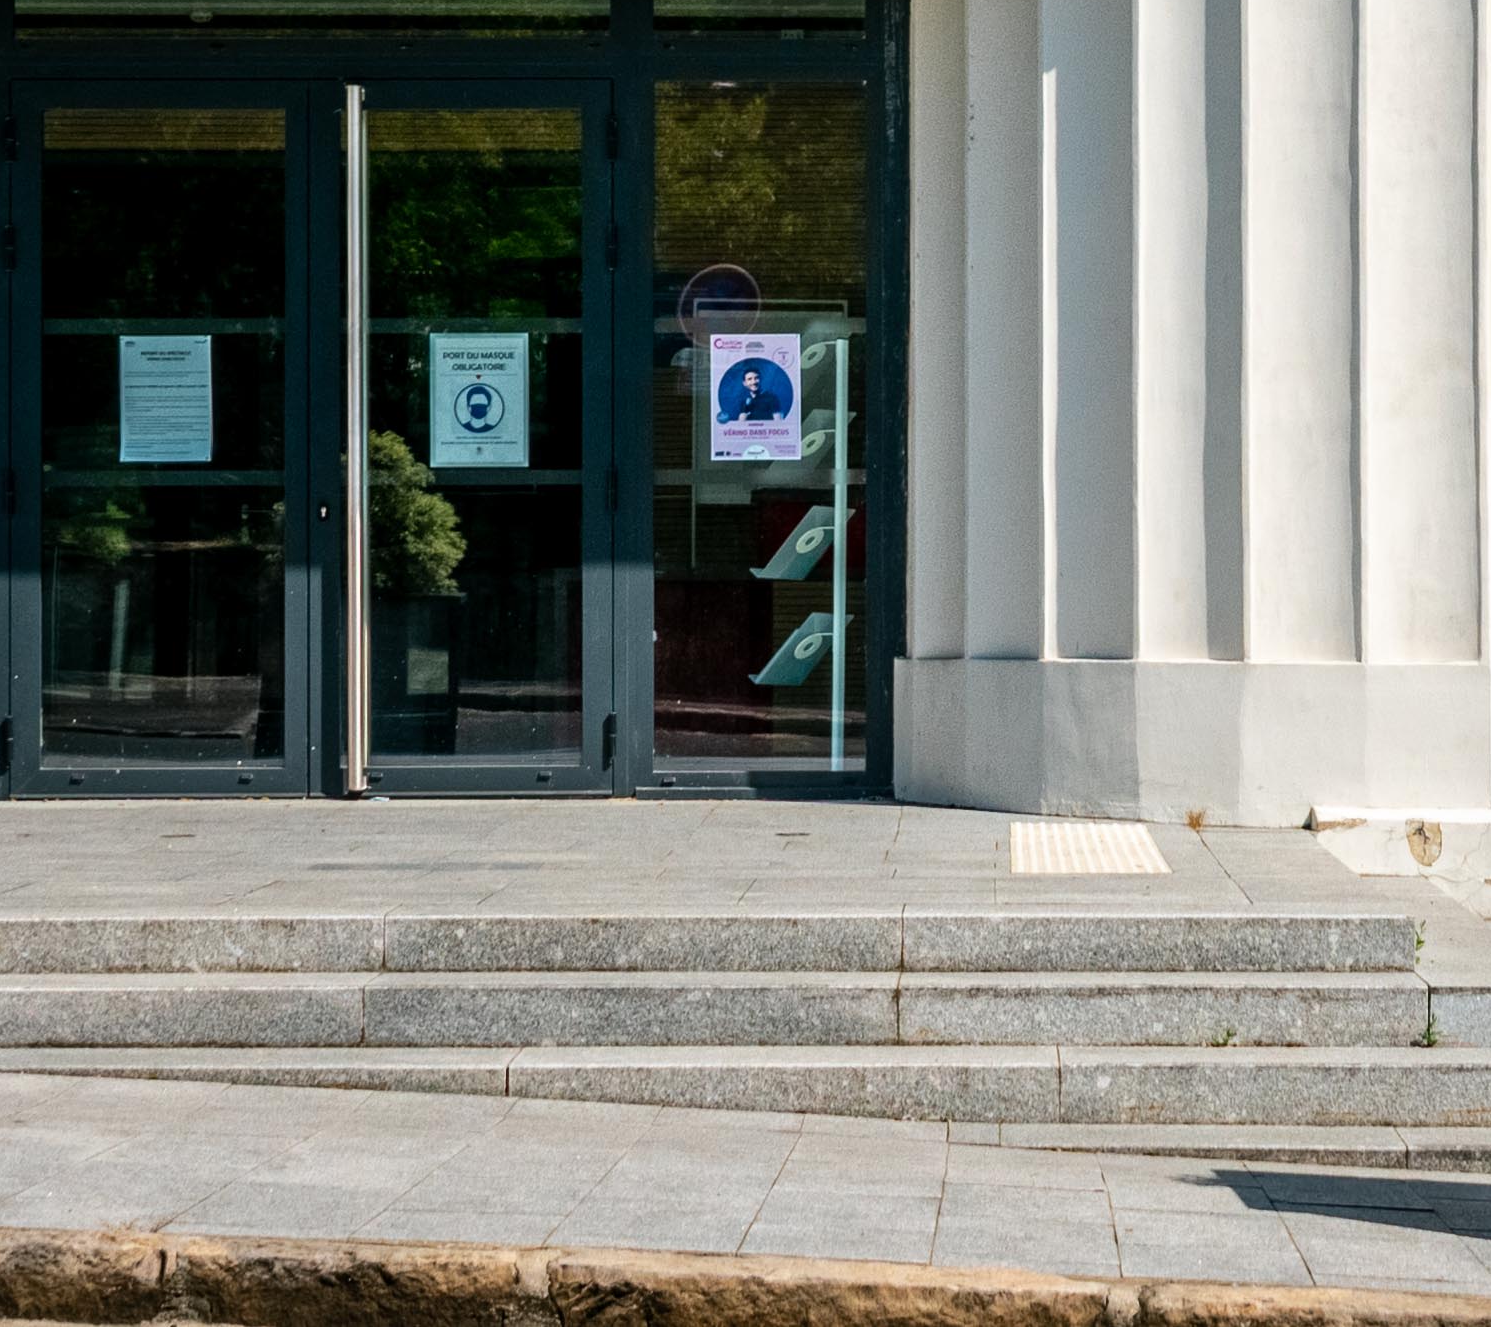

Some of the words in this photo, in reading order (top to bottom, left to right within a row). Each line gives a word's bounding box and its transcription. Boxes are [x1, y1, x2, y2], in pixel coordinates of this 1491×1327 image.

[442, 351, 465, 360] PORT
[466, 351, 479, 360] DU
[480, 351, 515, 360] MASQUE
[452, 363, 506, 371] OBLIGATOIRE
